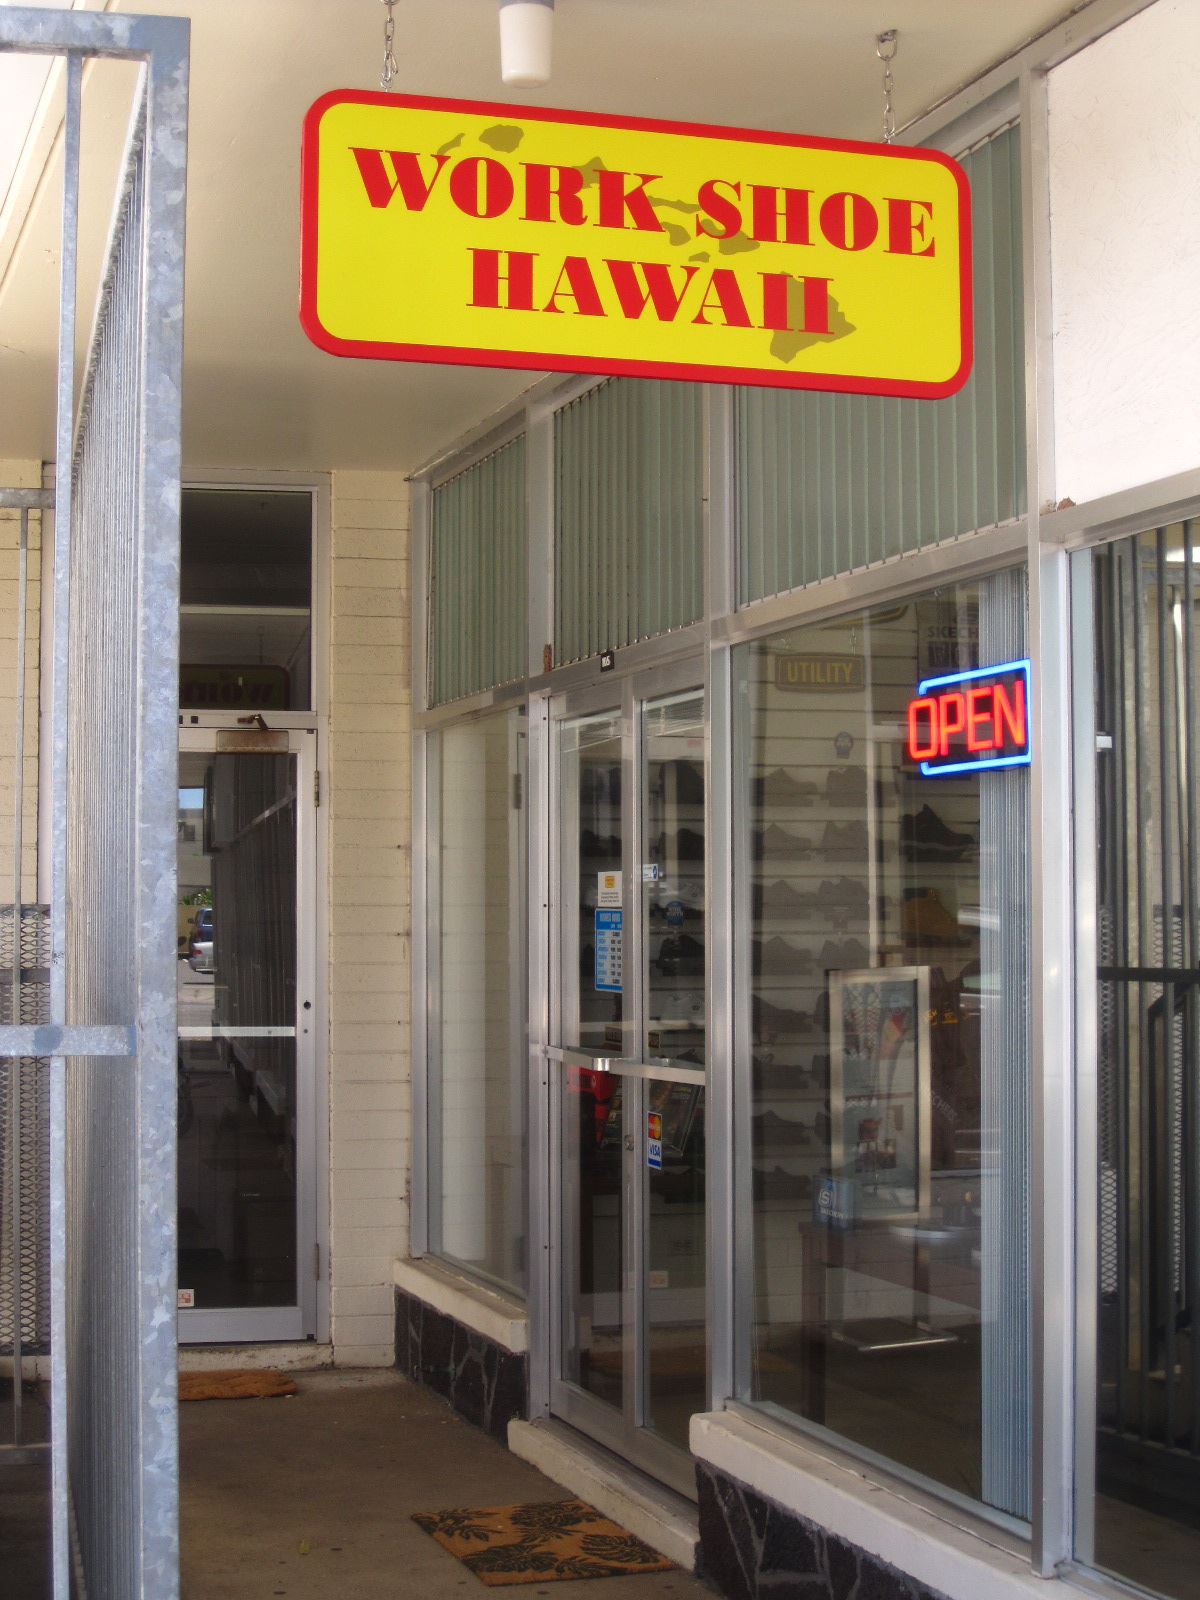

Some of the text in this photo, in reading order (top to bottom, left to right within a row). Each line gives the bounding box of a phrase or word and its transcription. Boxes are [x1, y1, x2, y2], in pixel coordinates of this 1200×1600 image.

[347, 146, 937, 258] WORK SHOE
[465, 247, 836, 335] HAWAII
[787, 662, 853, 684] UTILITY
[907, 679, 1026, 760] OPEN
[649, 1143, 661, 1158] VISA
